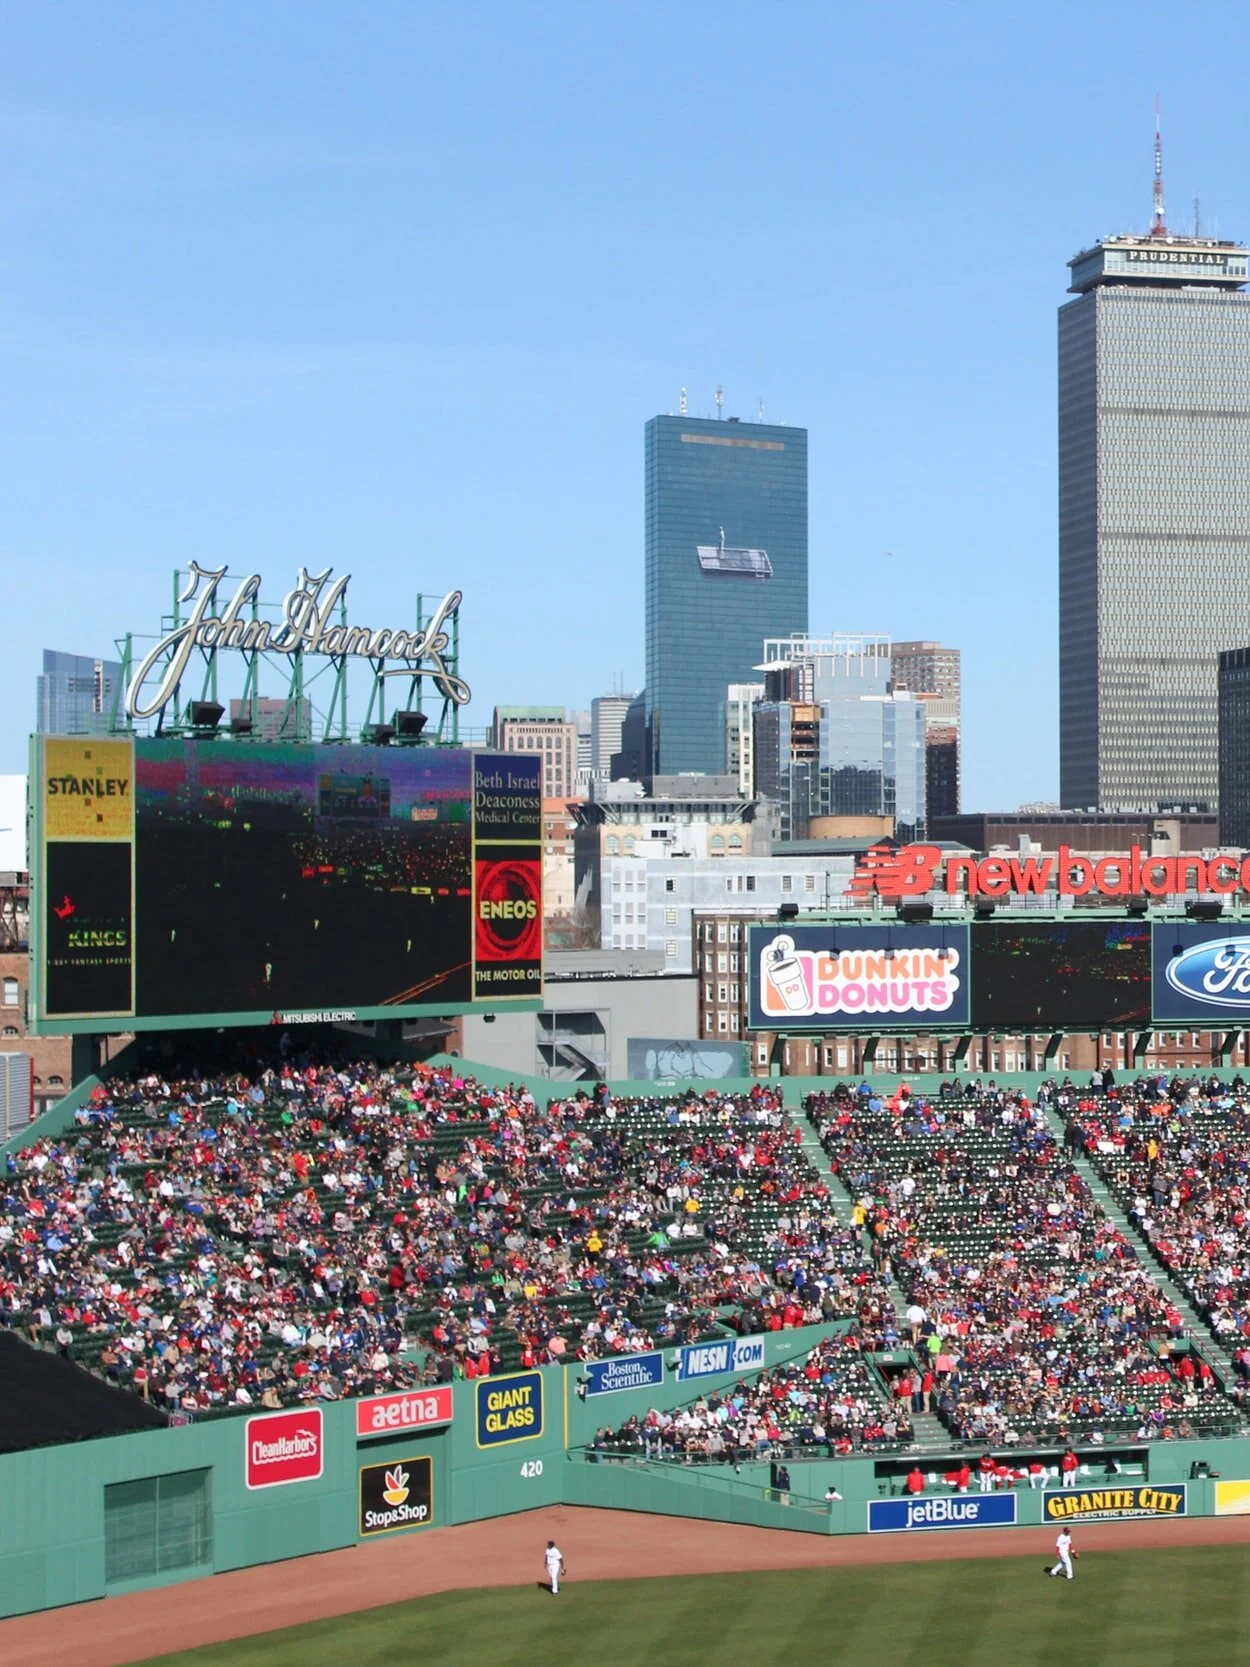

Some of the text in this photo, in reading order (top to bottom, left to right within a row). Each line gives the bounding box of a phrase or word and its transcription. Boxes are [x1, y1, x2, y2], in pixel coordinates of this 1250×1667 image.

[1129, 251, 1225, 264] PRUDENTIAL
[126, 560, 471, 719] John Hancock
[48, 777, 128, 798] STANLEY
[475, 771, 540, 789] Beth Israel
[475, 790, 540, 810] Deaconess
[475, 810, 541, 824] Medical Center
[946, 855, 1054, 895] new
[480, 900, 537, 920] ENEOS
[475, 968, 541, 982] THE MOTOR OIL
[818, 982, 948, 1008] DONUTS
[323, 1011, 357, 1022] ELECTRIC
[608, 1361, 641, 1378] Boston
[601, 1370, 653, 1390] Scientific
[487, 1386, 533, 1411] GIANT
[372, 1397, 438, 1428] aetna
[485, 1406, 535, 1432] GLASS
[520, 1460, 543, 1478] 420
[1047, 1488, 1182, 1518] GRANITE CITY
[905, 1500, 979, 1527] jetBlue
[1073, 1508, 1157, 1519] ELECTRIC SUPPLY
